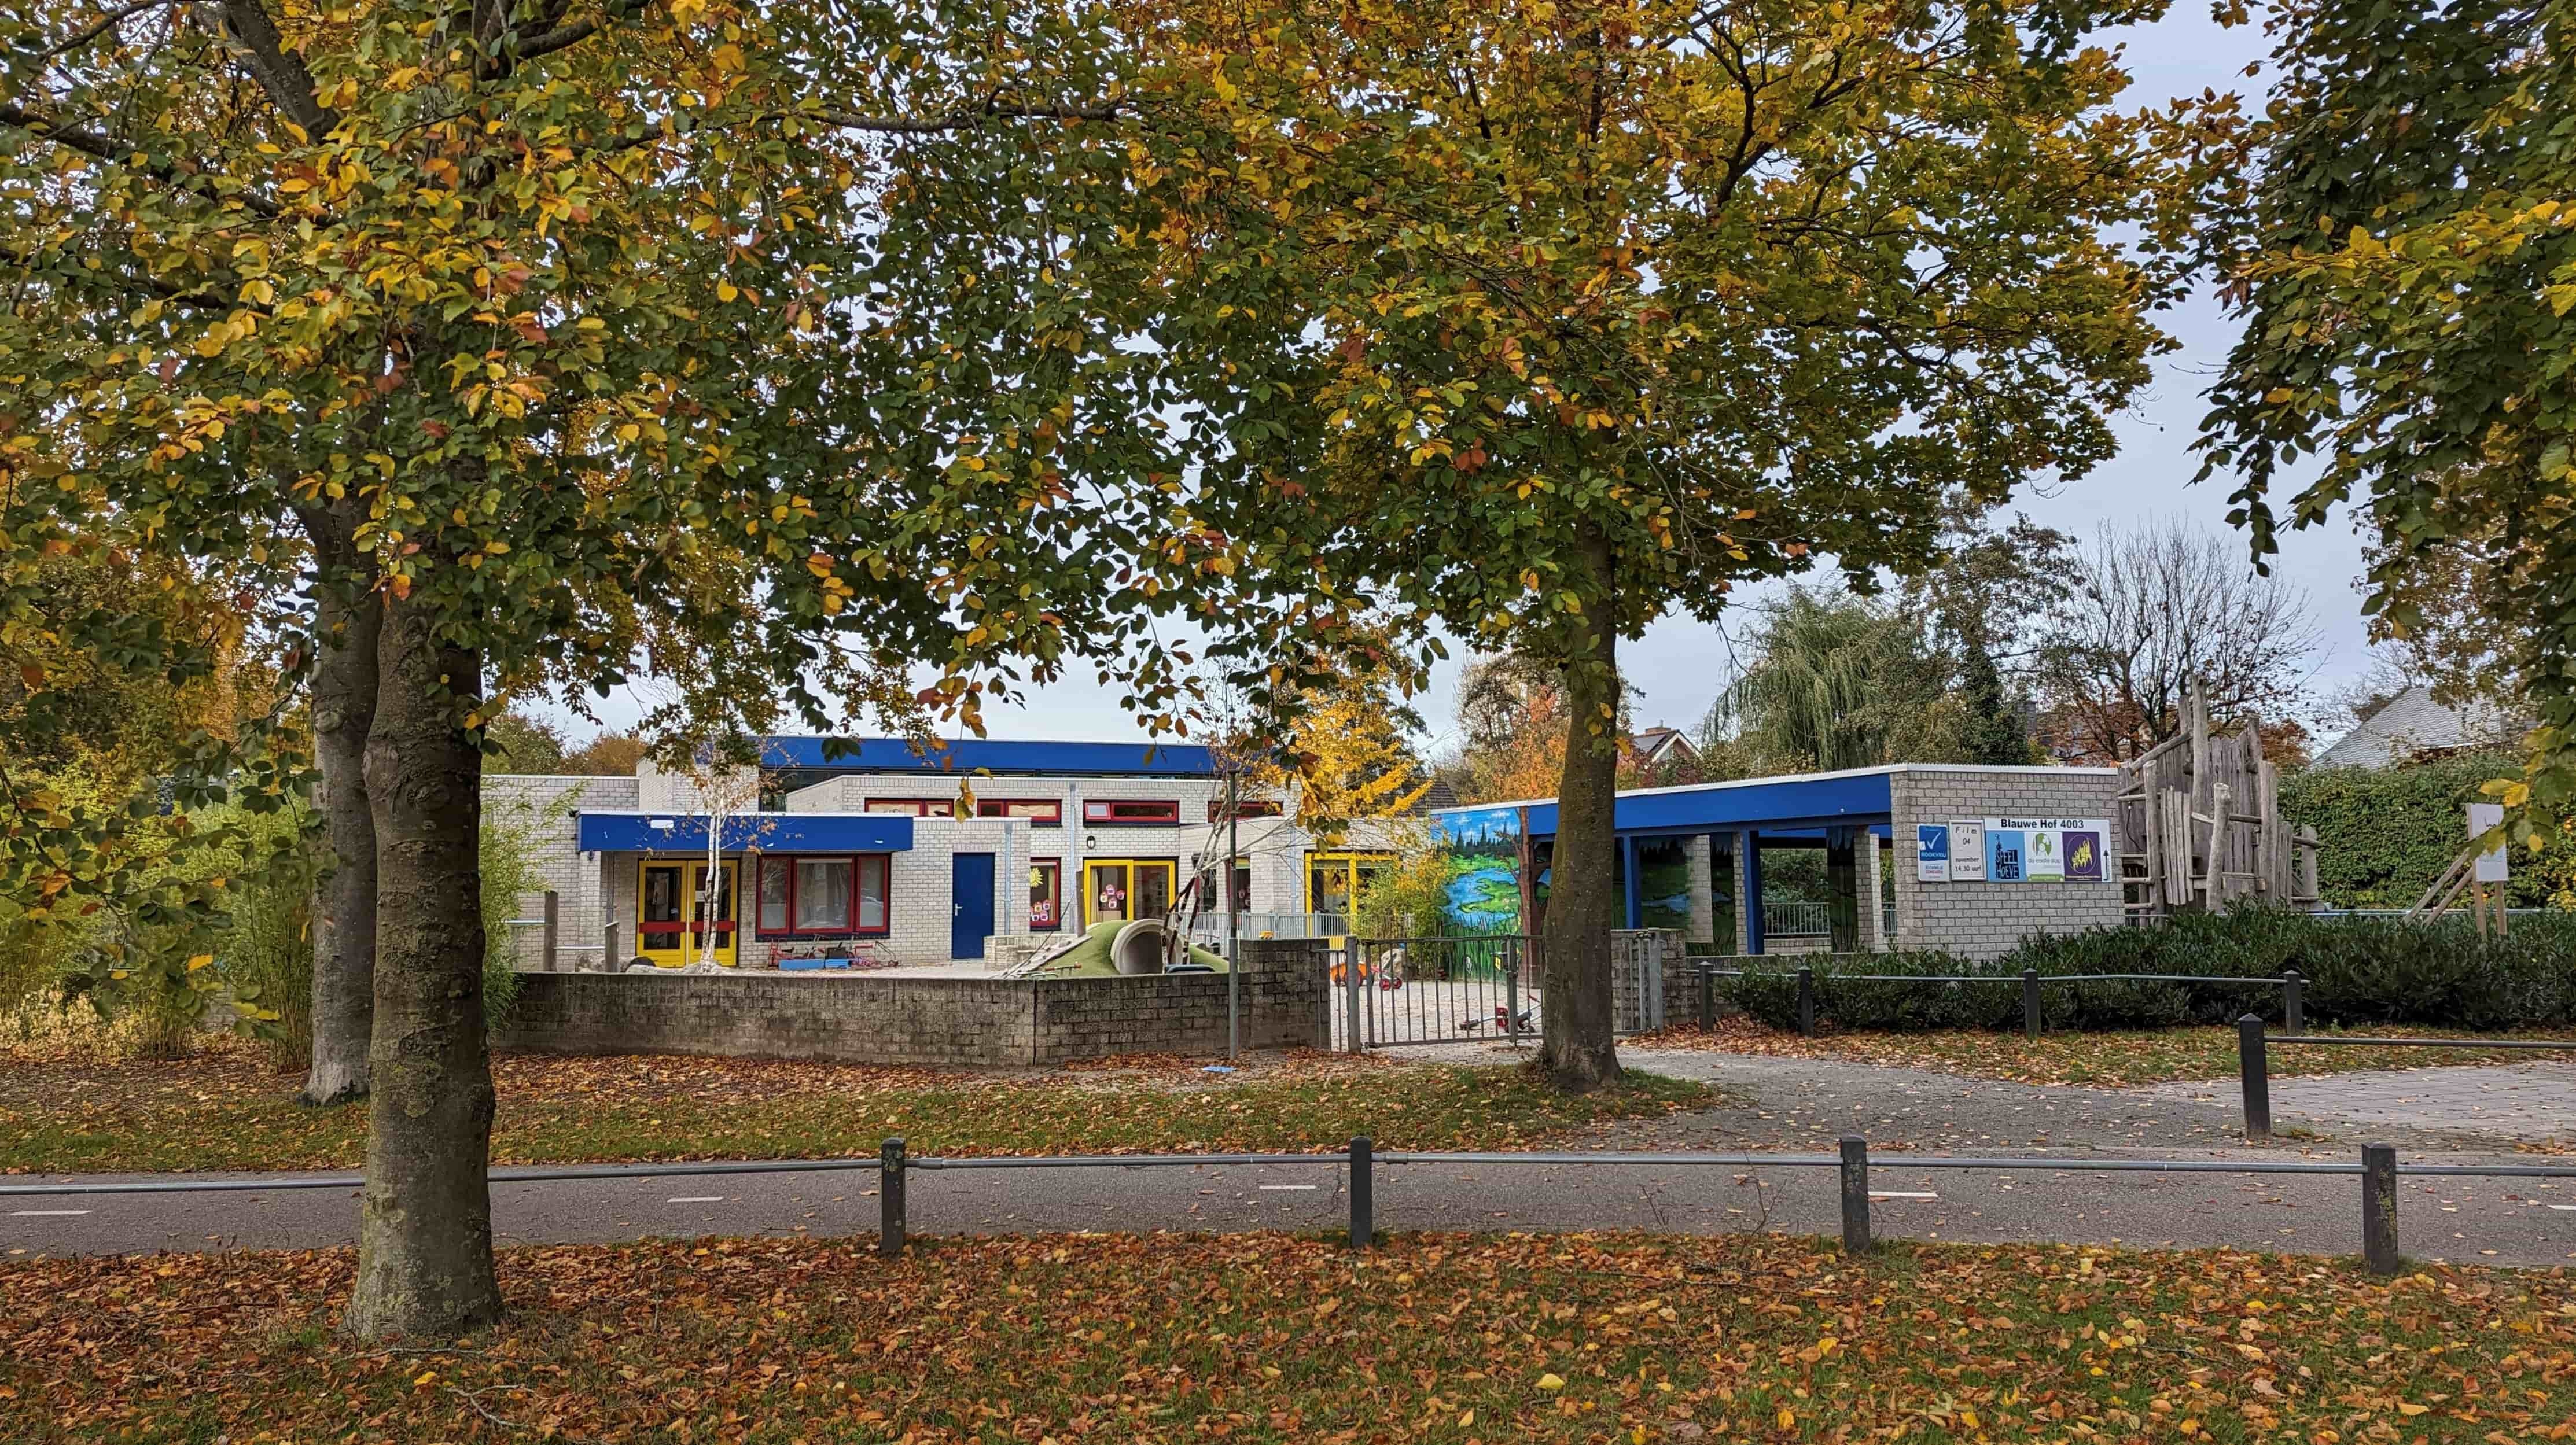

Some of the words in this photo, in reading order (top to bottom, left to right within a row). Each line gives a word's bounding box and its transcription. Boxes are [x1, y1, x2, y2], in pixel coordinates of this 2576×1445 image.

[2000, 819, 2037, 828] Blauwe
[2040, 819, 2056, 828] Hof
[2060, 820, 2084, 828] 4003
